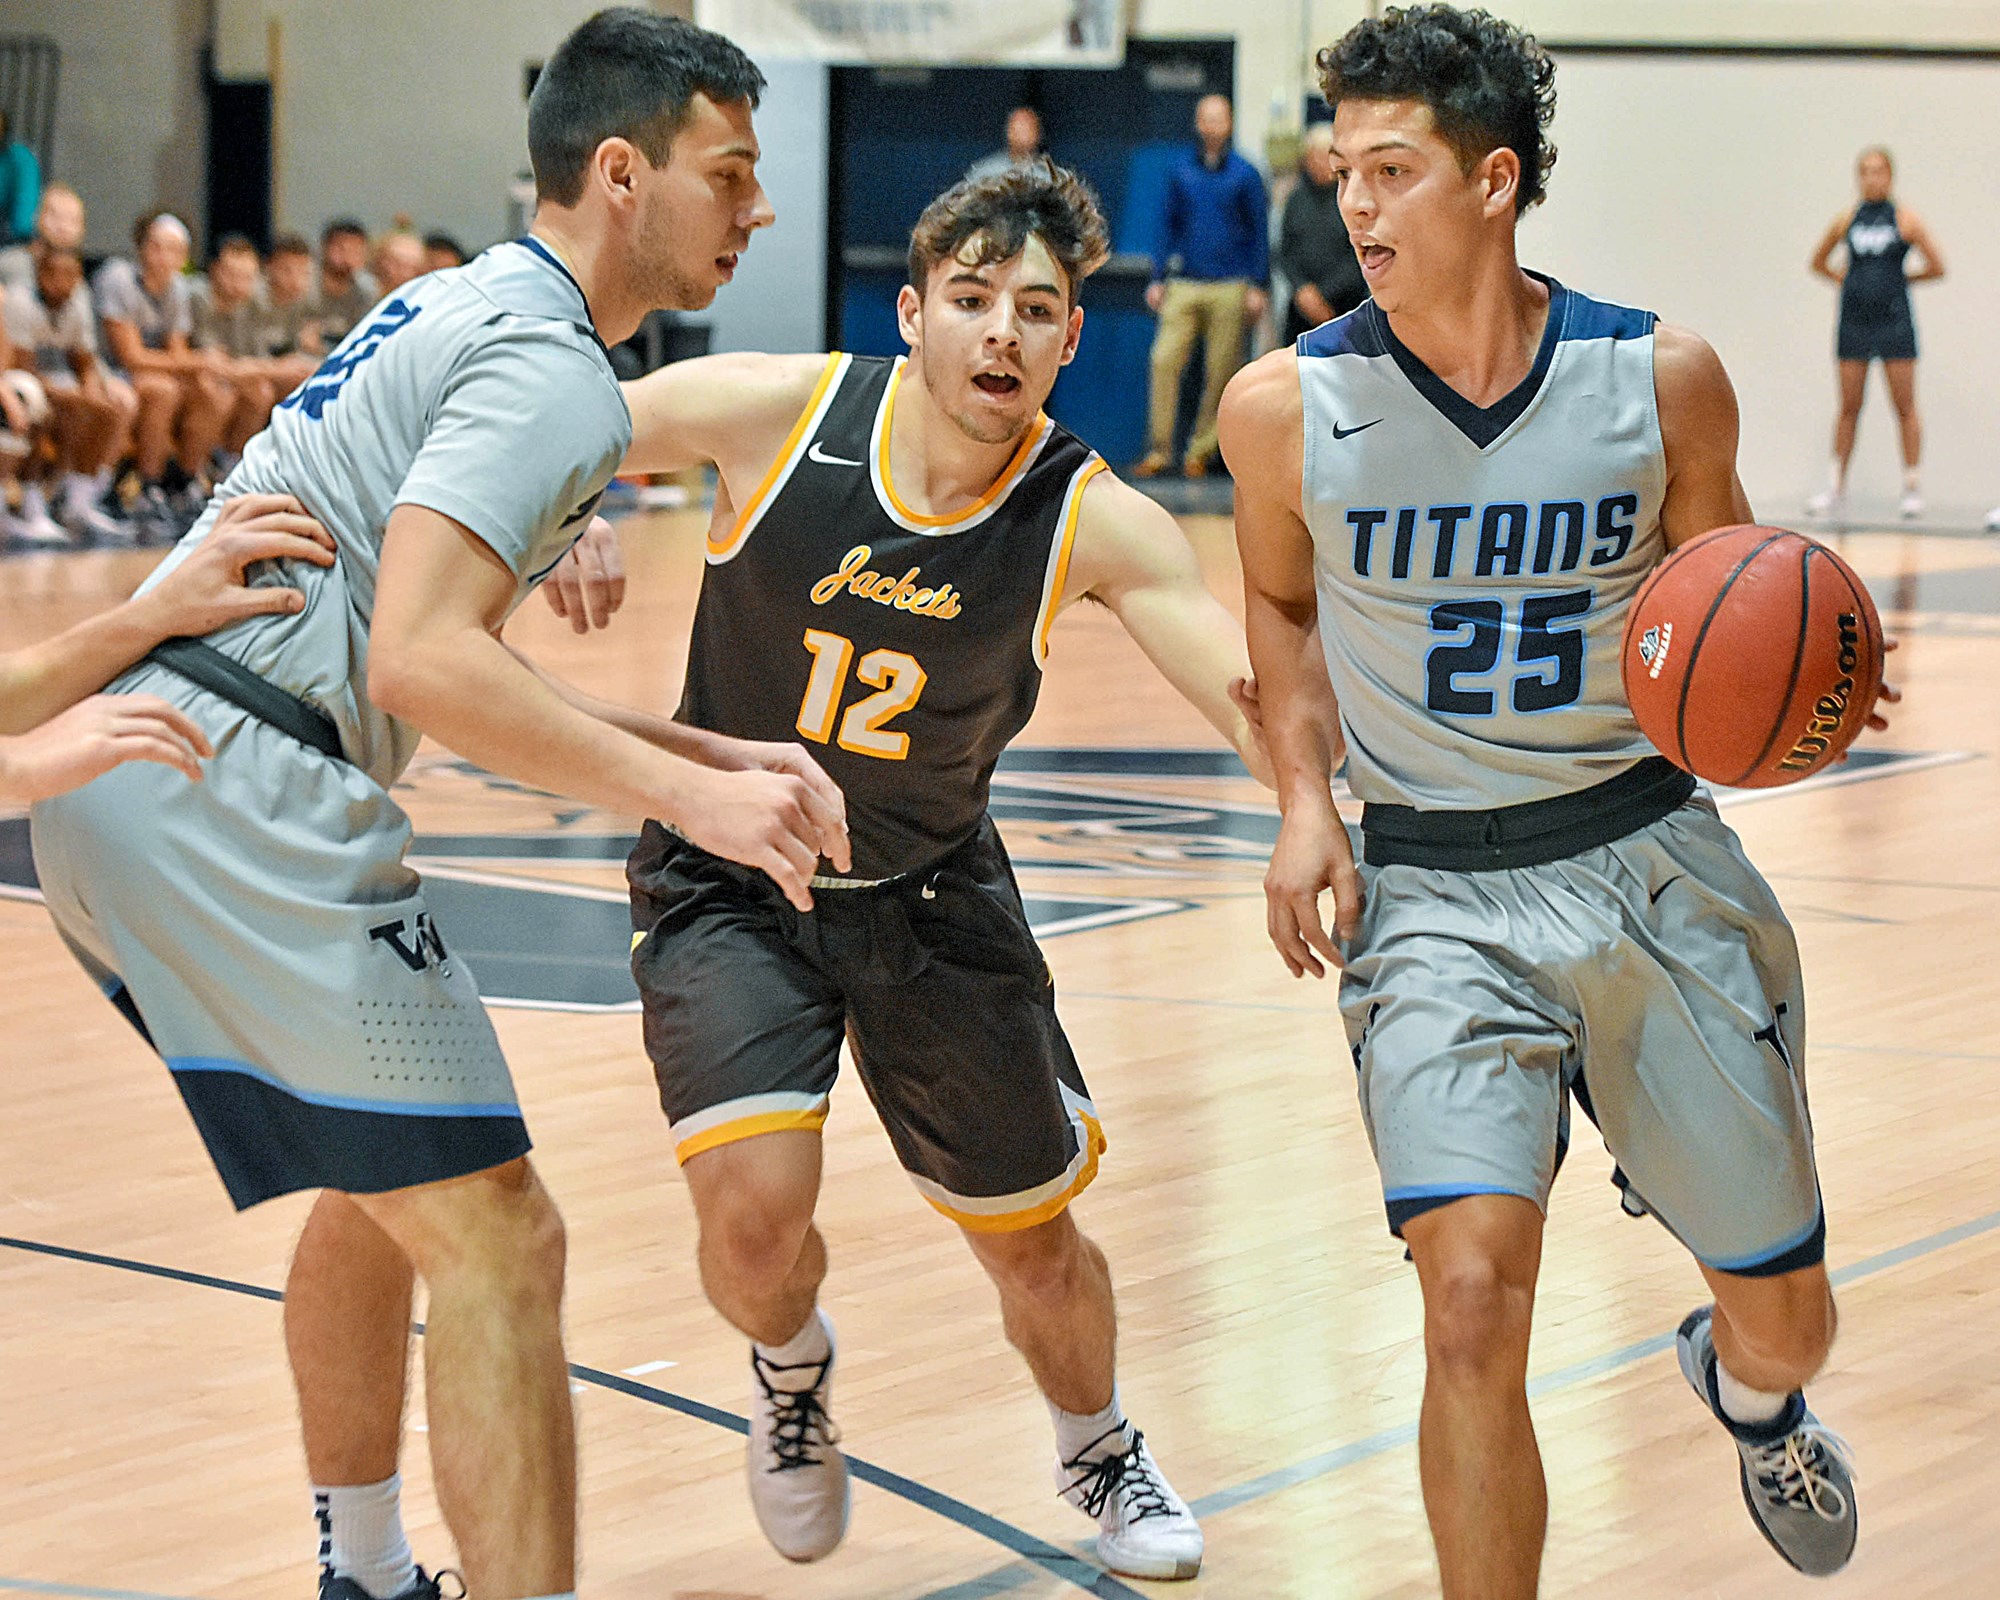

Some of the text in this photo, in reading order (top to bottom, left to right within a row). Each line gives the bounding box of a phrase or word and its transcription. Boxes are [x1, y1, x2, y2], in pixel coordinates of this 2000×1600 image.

[810, 545, 962, 619] Jackets
[1345, 492, 1639, 580] TITANS
[796, 628, 928, 760] 12
[1424, 588, 1595, 718] 25
[1649, 621, 1673, 680] TITANS
[1773, 608, 1858, 772] Wilson
